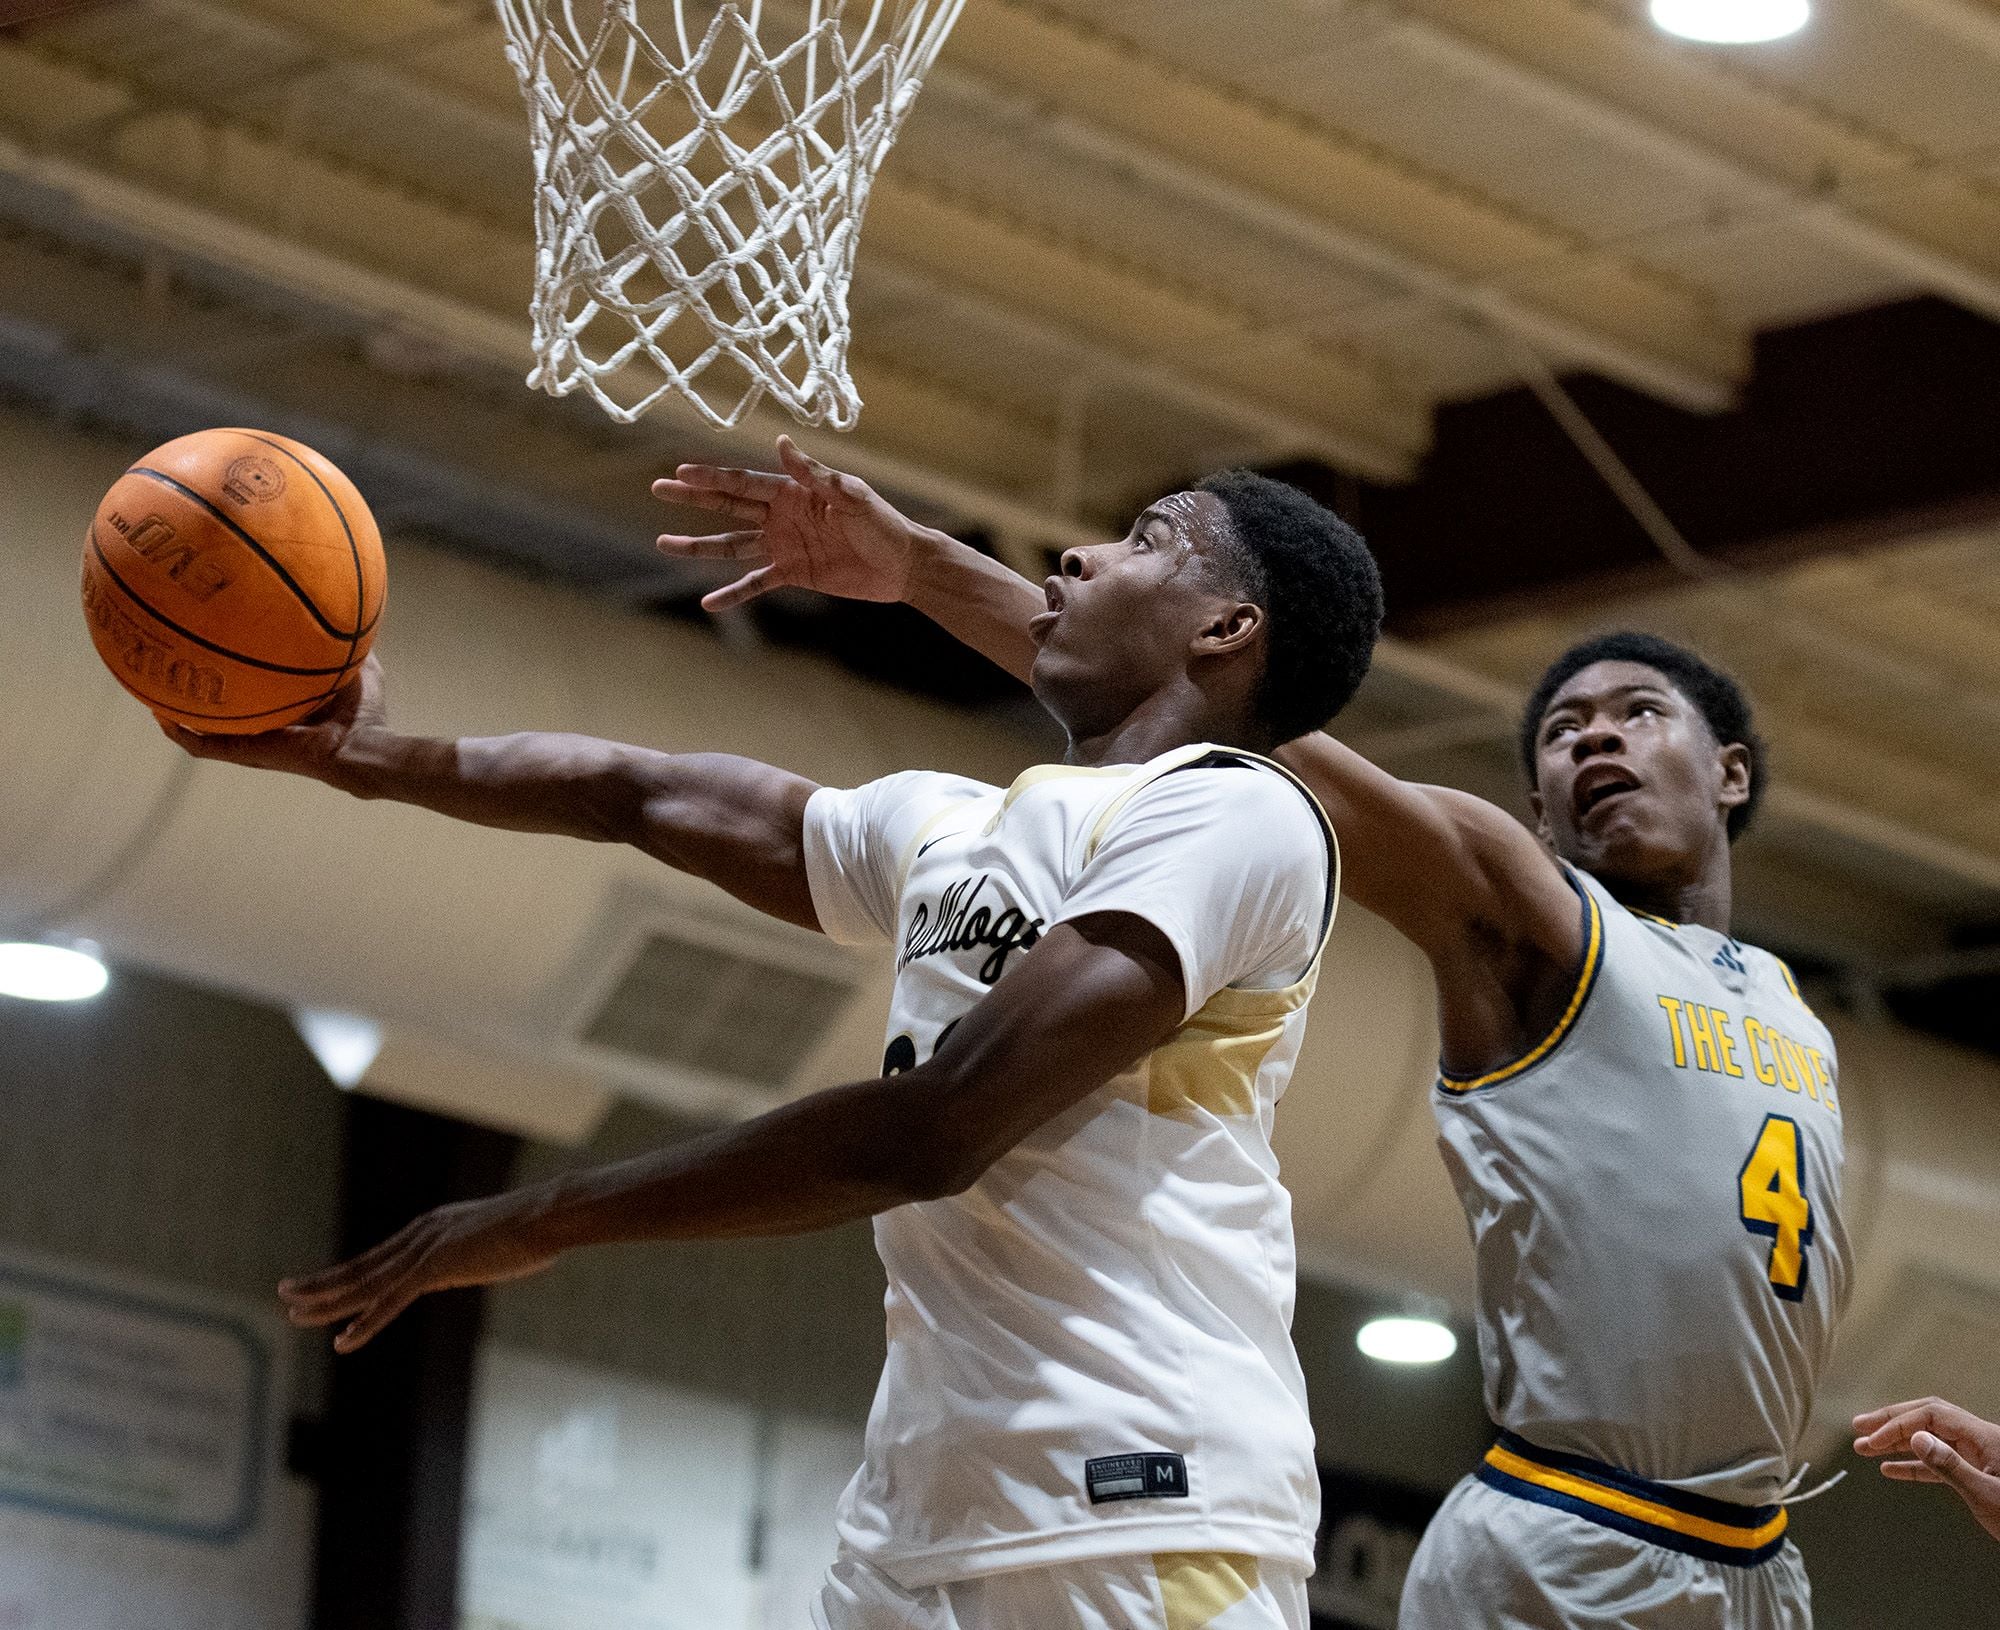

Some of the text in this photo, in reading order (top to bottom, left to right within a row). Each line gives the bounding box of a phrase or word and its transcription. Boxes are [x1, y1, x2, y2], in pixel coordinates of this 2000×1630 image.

[1658, 995, 1836, 1112] THE COVE
[1737, 1112, 1815, 1303] 4
[1156, 1465, 1174, 1483] M
